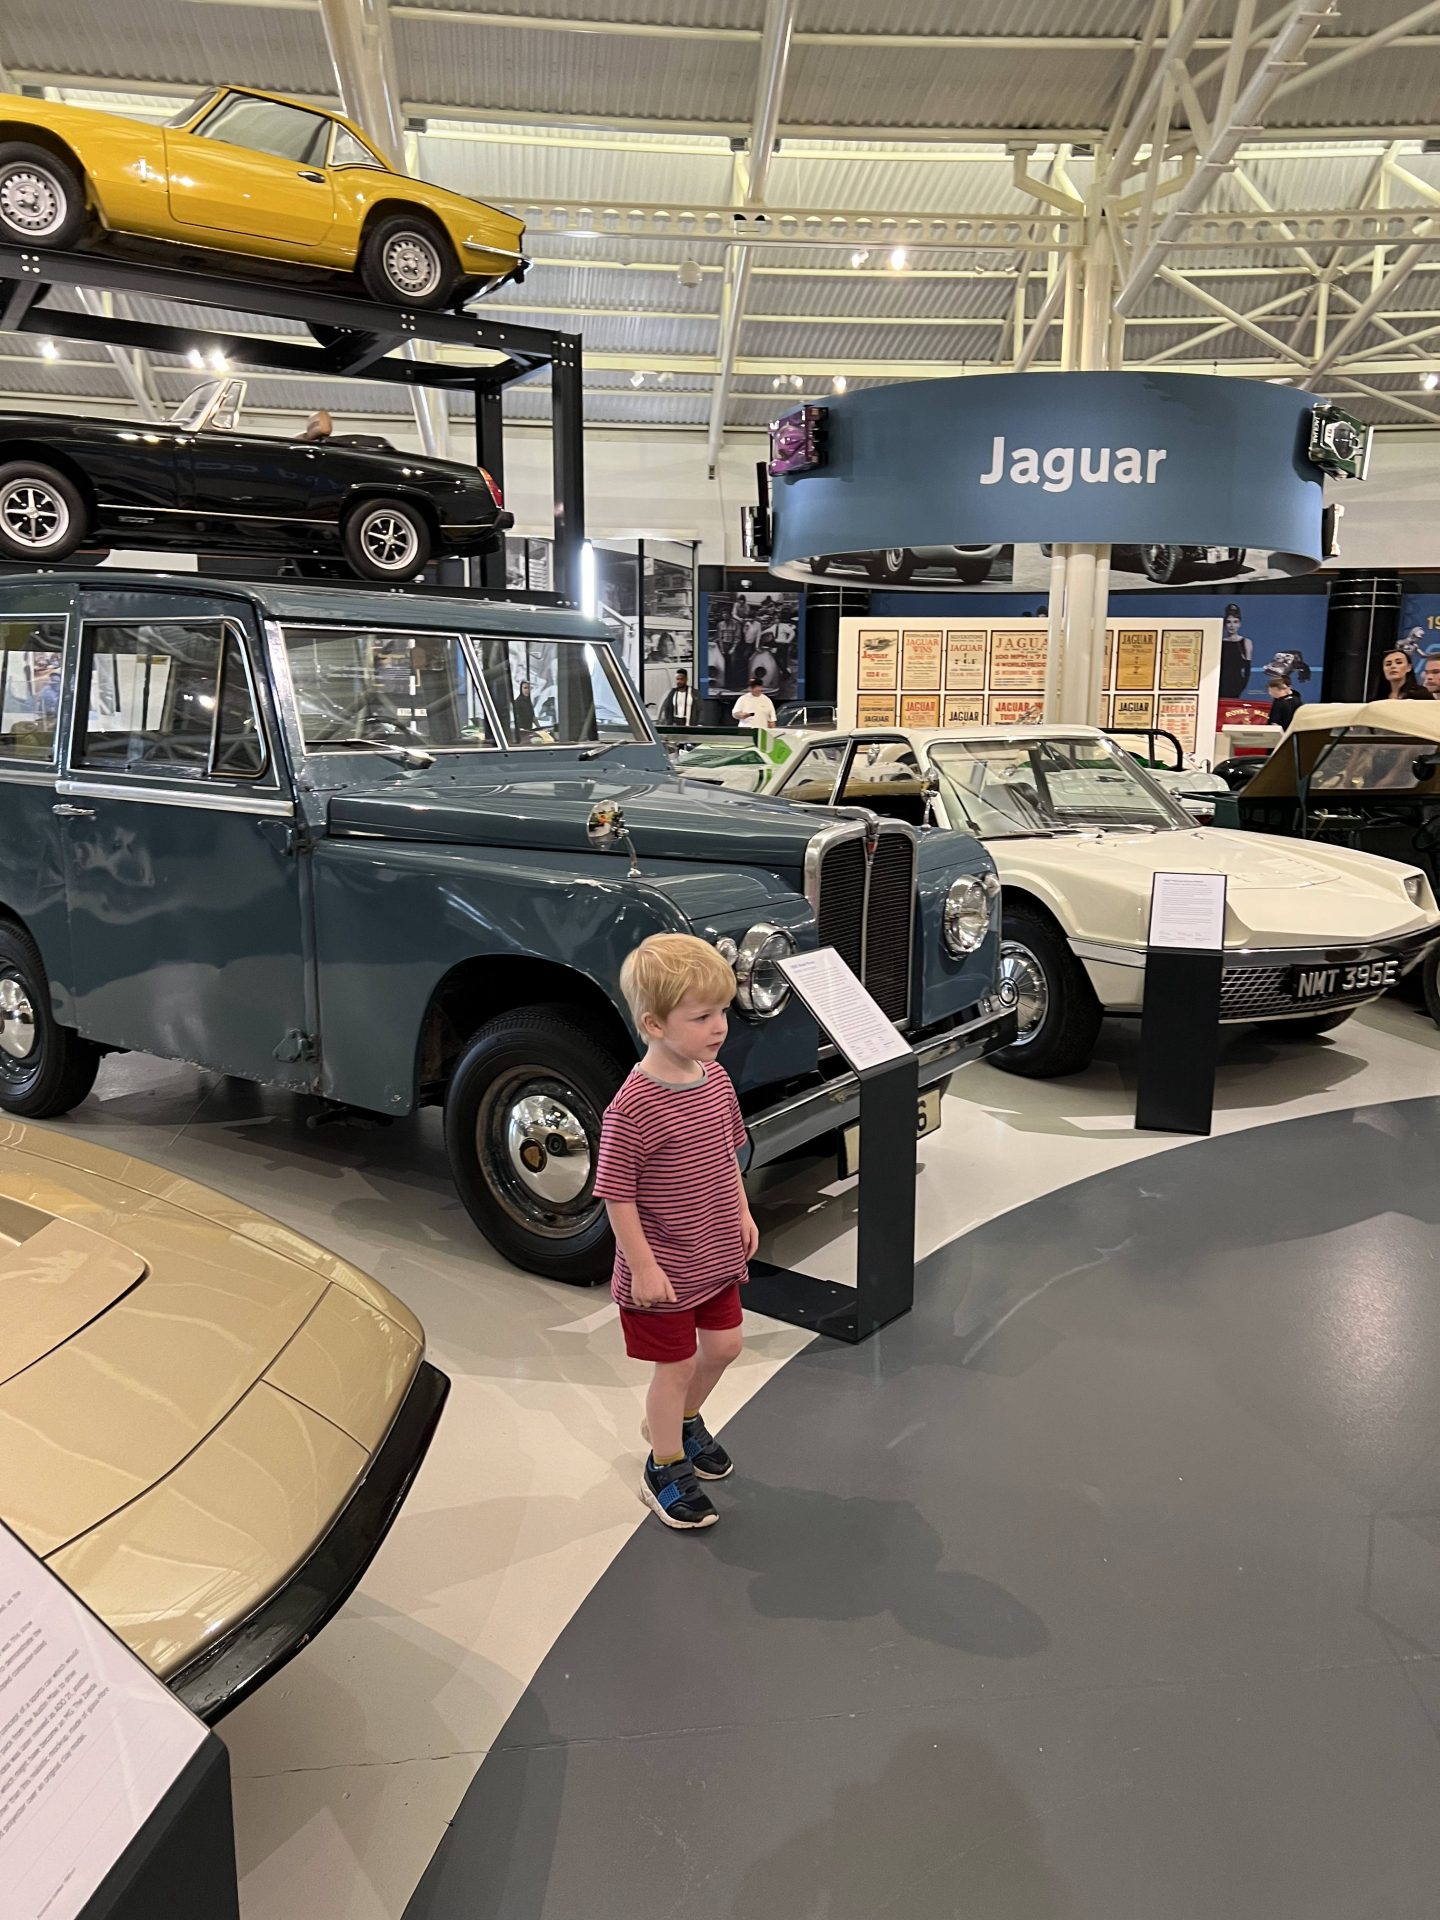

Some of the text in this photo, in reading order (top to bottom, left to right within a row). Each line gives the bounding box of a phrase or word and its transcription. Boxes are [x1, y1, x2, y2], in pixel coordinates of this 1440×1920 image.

[980, 436, 1167, 493] Jaguar
[1122, 634, 1153, 645] JAGUAR
[950, 644, 983, 652] JAGUAR
[861, 650, 888, 661] Jaguar
[905, 702, 935, 712] JAGUAR
[995, 702, 1029, 712] JAGUAR
[1118, 702, 1149, 712] JAGUAR
[1161, 704, 1195, 713] JAGUARS
[949, 712, 979, 722] JAGUAR
[1225, 709, 1249, 717] ROYAL
[1298, 960, 1399, 998] NMT 395E
[19, 1706, 26, 1714] of
[29, 1686, 45, 1703] sports
[44, 1678, 52, 1687] car
[52, 1664, 65, 1678] which
[66, 1648, 79, 1664] would
[12, 1727, 24, 1740] from
[24, 1718, 33, 1727] the
[33, 1701, 48, 1718] Austin
[14, 1760, 29, 1777] might
[27, 1748, 41, 1761] have
[38, 1727, 59, 1748] become
[58, 1719, 65, 1727] an
[72, 1698, 83, 1708] The
